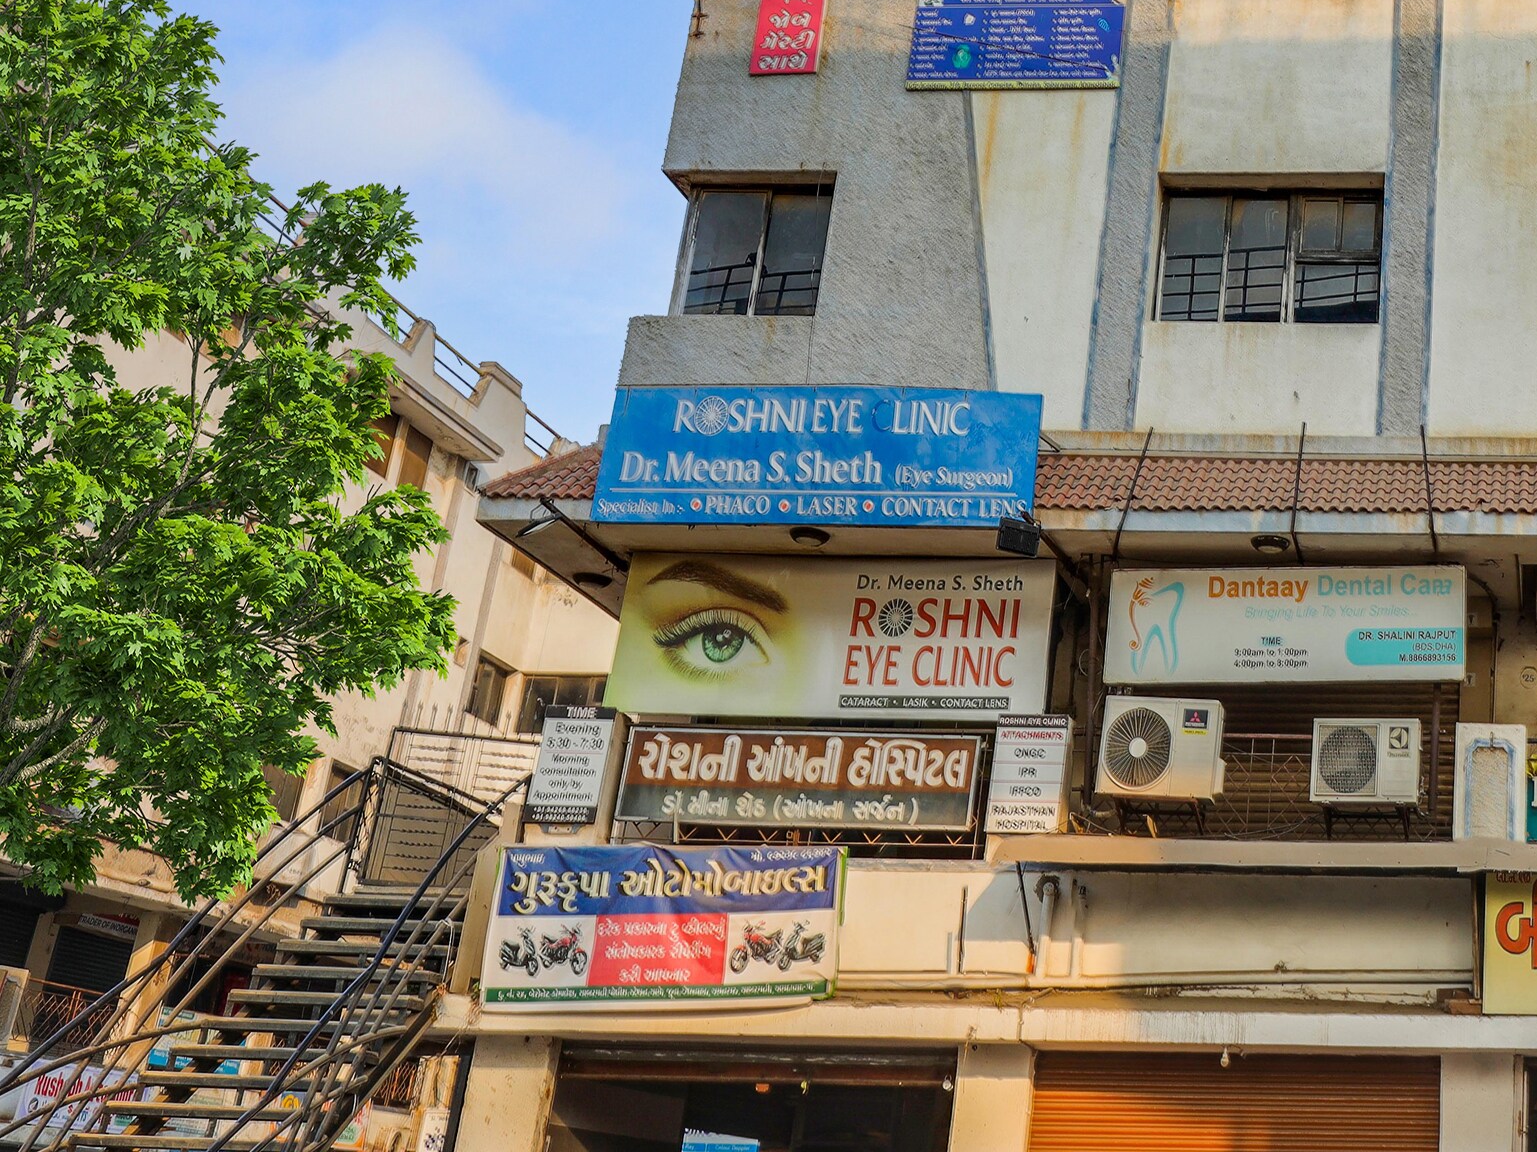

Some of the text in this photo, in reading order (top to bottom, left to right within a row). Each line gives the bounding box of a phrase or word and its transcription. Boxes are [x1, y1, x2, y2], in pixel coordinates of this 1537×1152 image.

[672, 395, 971, 437] ROSHNI EYE CLINIC
[619, 450, 1013, 491] Dr. Meena S. Sheth (Eye Surgeon)
[597, 498, 658, 517] Specialist
[705, 495, 771, 516] PHACO
[796, 496, 859, 516] LASER
[881, 496, 976, 518] CONTACT
[978, 498, 1027, 519] LENS
[857, 575, 1024, 591] Dr. Meena S. Sheth
[1208, 576, 1309, 603] Dantaay
[1317, 574, 1391, 597] Dental
[849, 598, 1021, 638] ROSHNI
[1322, 605, 1336, 617] To
[1340, 605, 1365, 618] Your
[1358, 630, 1456, 641] DR. SHALINI RAJPUT
[843, 645, 1016, 688] EYE CLINIC
[566, 706, 597, 719] TIME
[841, 697, 1008, 709] CATARACT LASIK CONTACT LENS
[555, 721, 601, 738] Evening
[1001, 730, 1064, 741] ATTACHMENTS
[552, 753, 590, 767] Morning
[638, 732, 969, 788] રોશની આંખની હોસ્પિટલ
[688, 790, 729, 817] મીના
